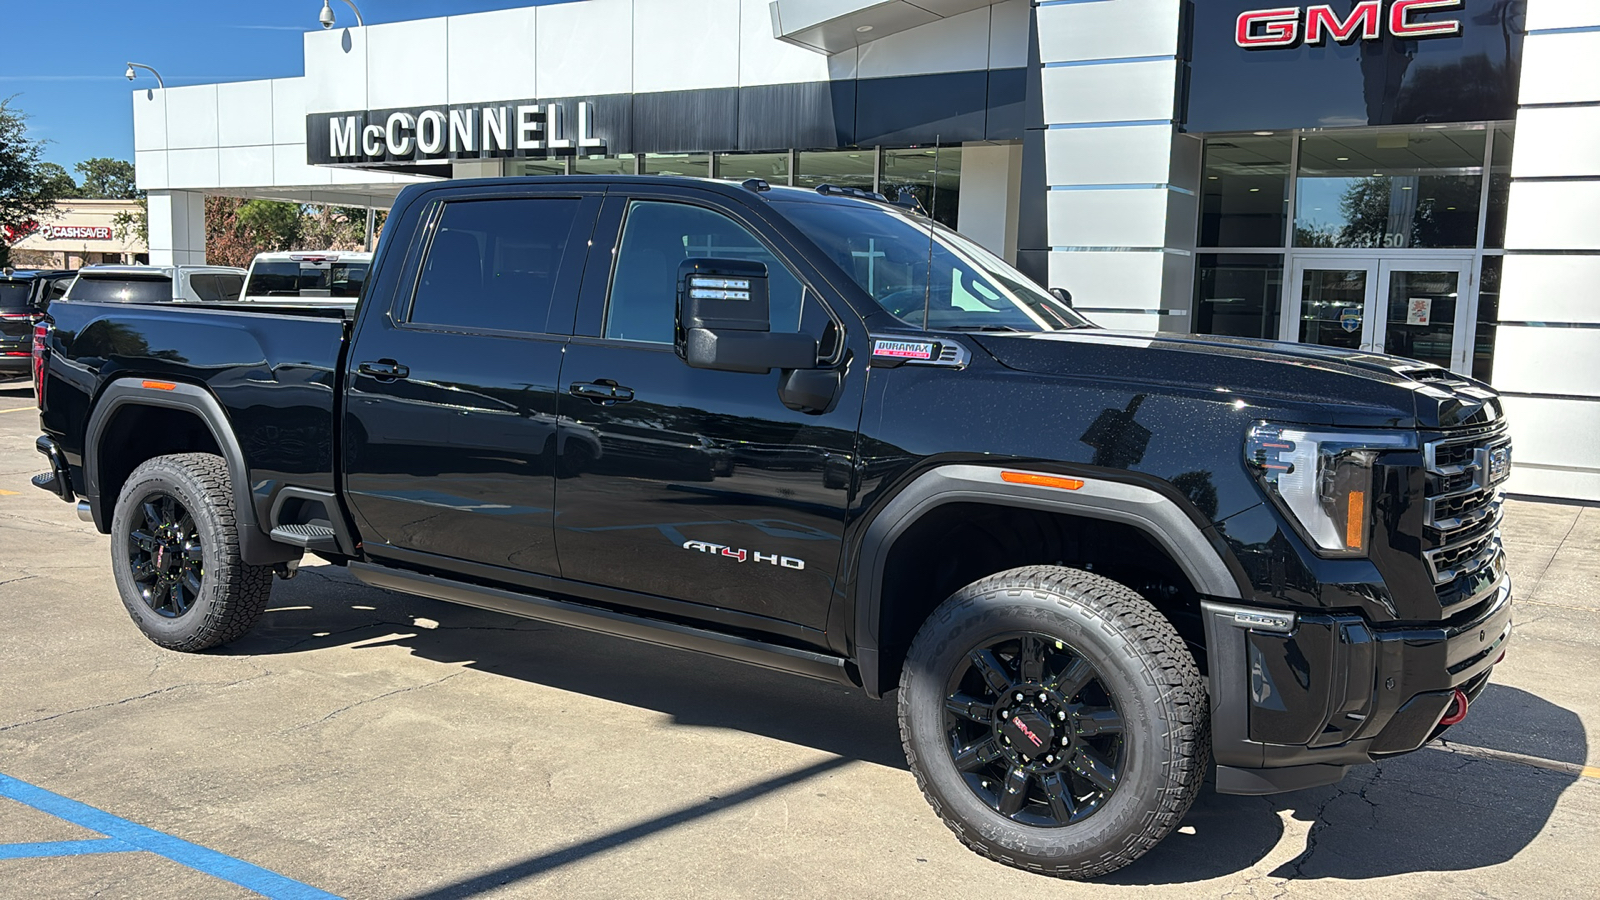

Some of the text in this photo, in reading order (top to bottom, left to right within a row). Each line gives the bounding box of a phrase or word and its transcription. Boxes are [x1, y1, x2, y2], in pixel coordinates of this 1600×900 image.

[1235, 0, 1464, 47] GMC
[329, 101, 605, 157] McCONNELL
[879, 341, 929, 353] DURAMAX
[683, 540, 805, 570] AT4 HD
[1012, 716, 1043, 747] GMC
